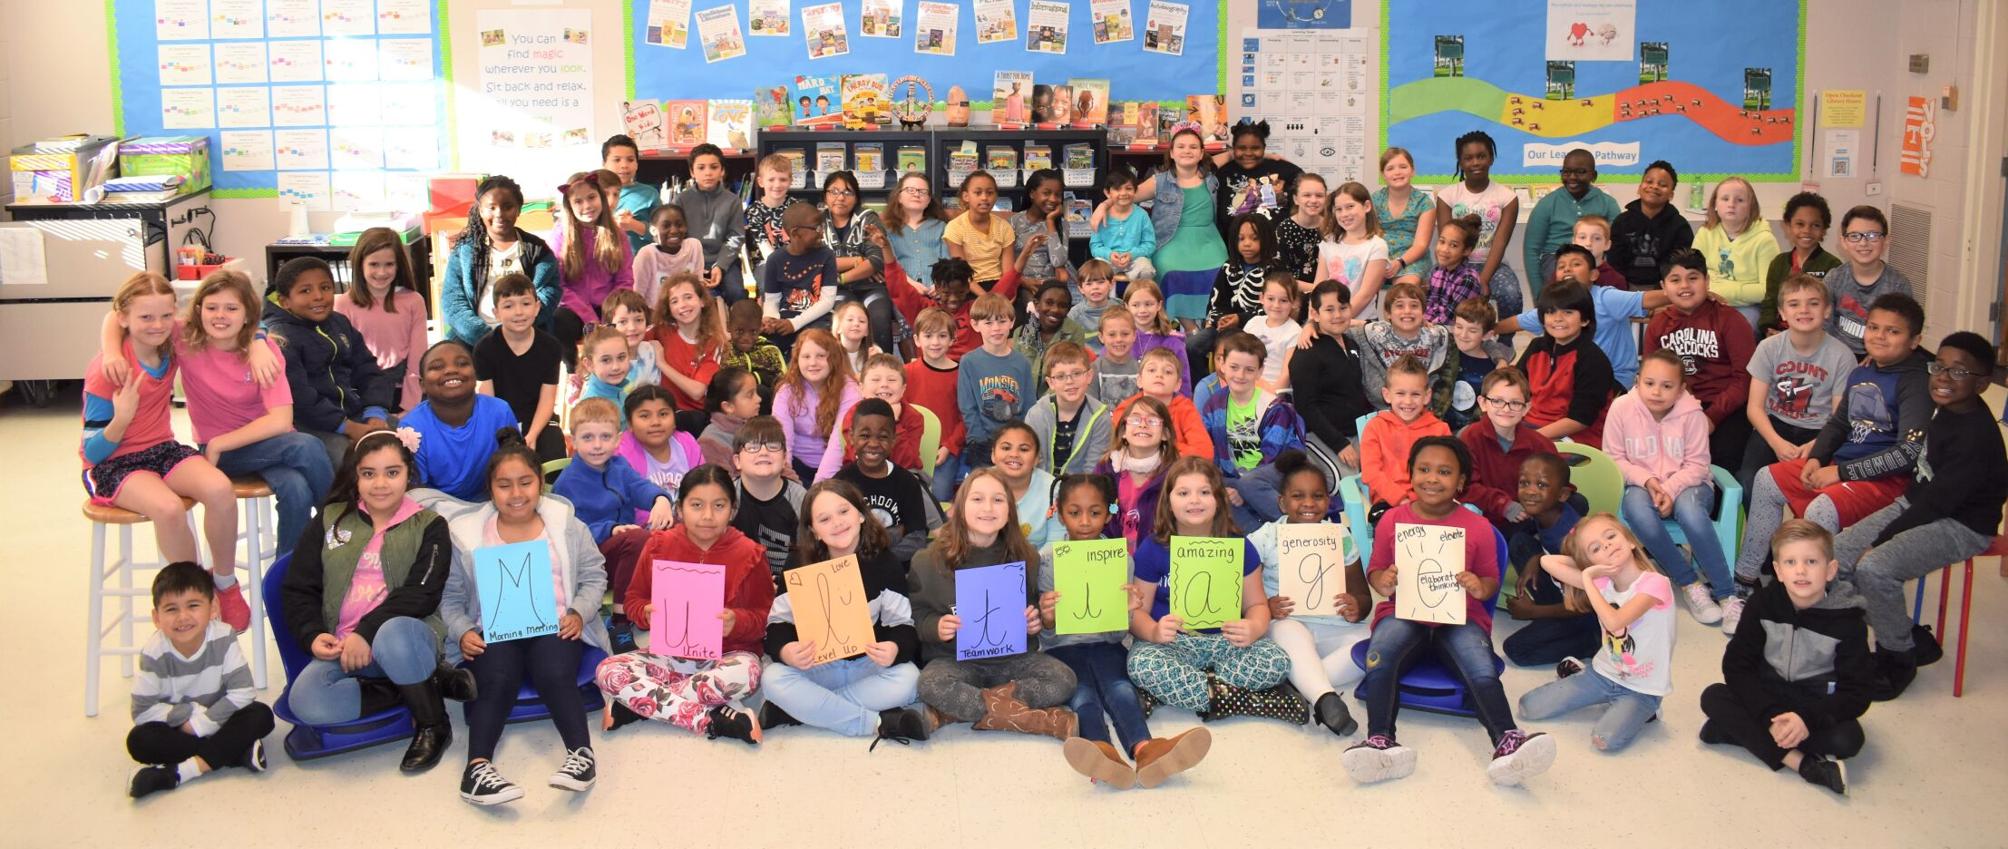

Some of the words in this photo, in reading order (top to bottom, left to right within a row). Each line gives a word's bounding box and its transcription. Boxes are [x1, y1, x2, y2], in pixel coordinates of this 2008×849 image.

[512, 34, 534, 45] You
[536, 35, 557, 44] can
[507, 49, 530, 59] find
[533, 49, 564, 60] magic
[484, 65, 536, 74] wherever
[538, 66, 557, 75] you
[486, 82, 503, 93] Sit
[504, 82, 530, 92] back
[533, 82, 554, 92] and
[557, 82, 587, 92] relax.
[510, 99, 529, 108] you
[532, 98, 558, 107] need
[561, 98, 570, 107] is
[572, 99, 580, 107] a
[712, 110, 749, 125] LOVE
[1919, 98, 1937, 179] VOLS
[1527, 150, 1546, 160] Our
[1595, 151, 1637, 162] Pathway
[1660, 327, 1718, 349] CAROLINA
[1776, 360, 1829, 382] COUNT
[1625, 435, 1657, 459] OLD
[1397, 526, 1427, 543] energy
[1439, 529, 1465, 542] elevate
[1282, 536, 1338, 555] generosity
[1176, 546, 1235, 564] amazing
[1298, 552, 1336, 610] g
[1417, 558, 1448, 608] e
[1420, 571, 1458, 585] elaborat
[488, 551, 546, 630] M
[1184, 570, 1222, 618] a
[1429, 581, 1460, 592] thinking
[971, 588, 1008, 649] t
[489, 630, 523, 642] Morning
[682, 647, 718, 659] Unite
